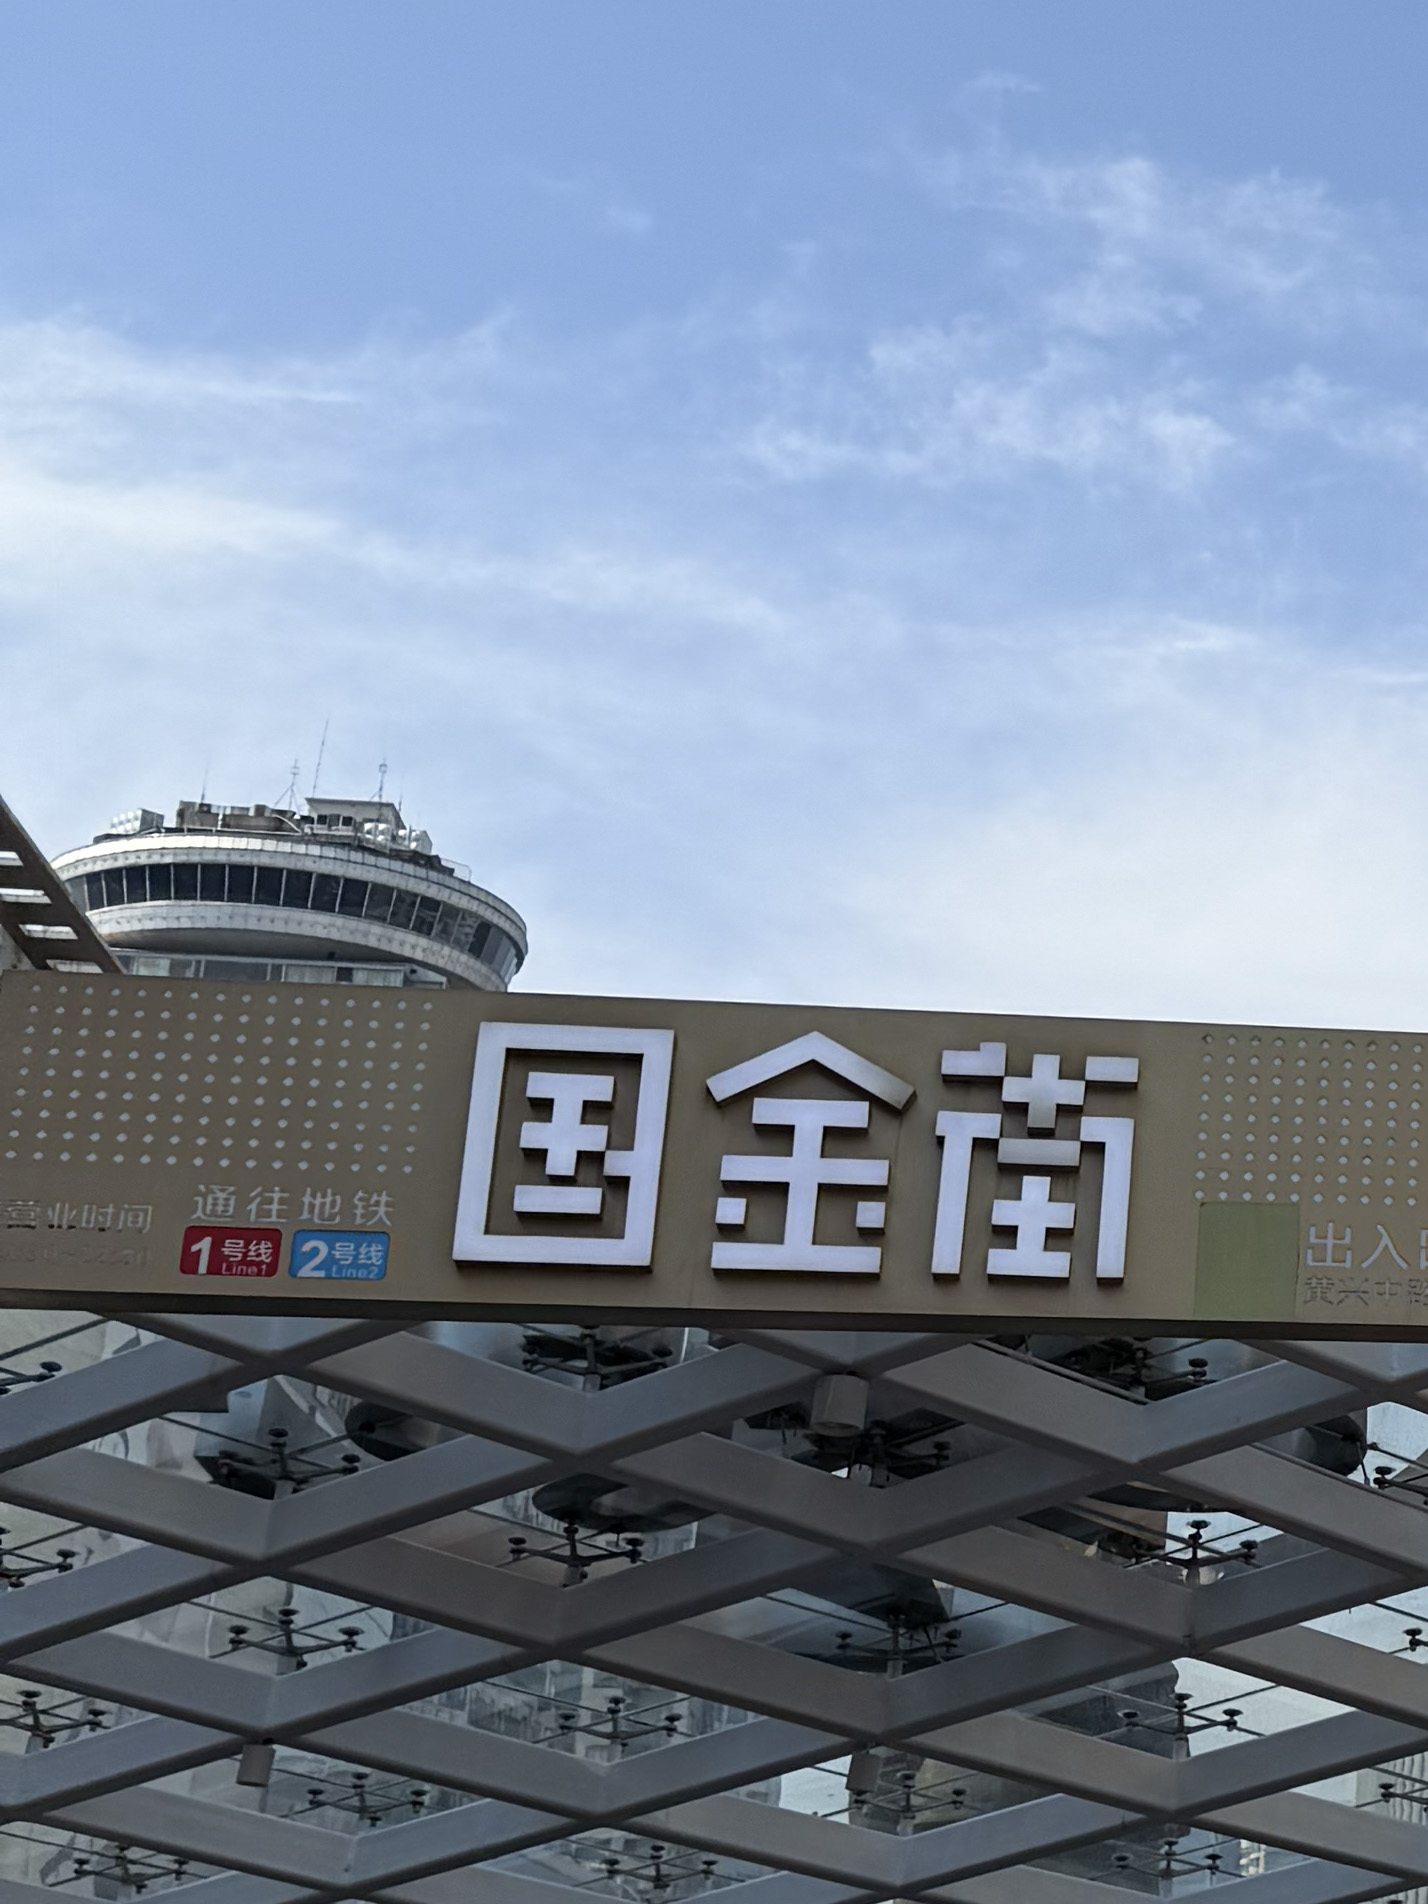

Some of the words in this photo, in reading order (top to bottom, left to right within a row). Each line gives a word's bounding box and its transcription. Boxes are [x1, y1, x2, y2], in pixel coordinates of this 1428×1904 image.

[3, 1200, 154, 1234] 营业时间
[189, 1184, 395, 1227] 通往地铁
